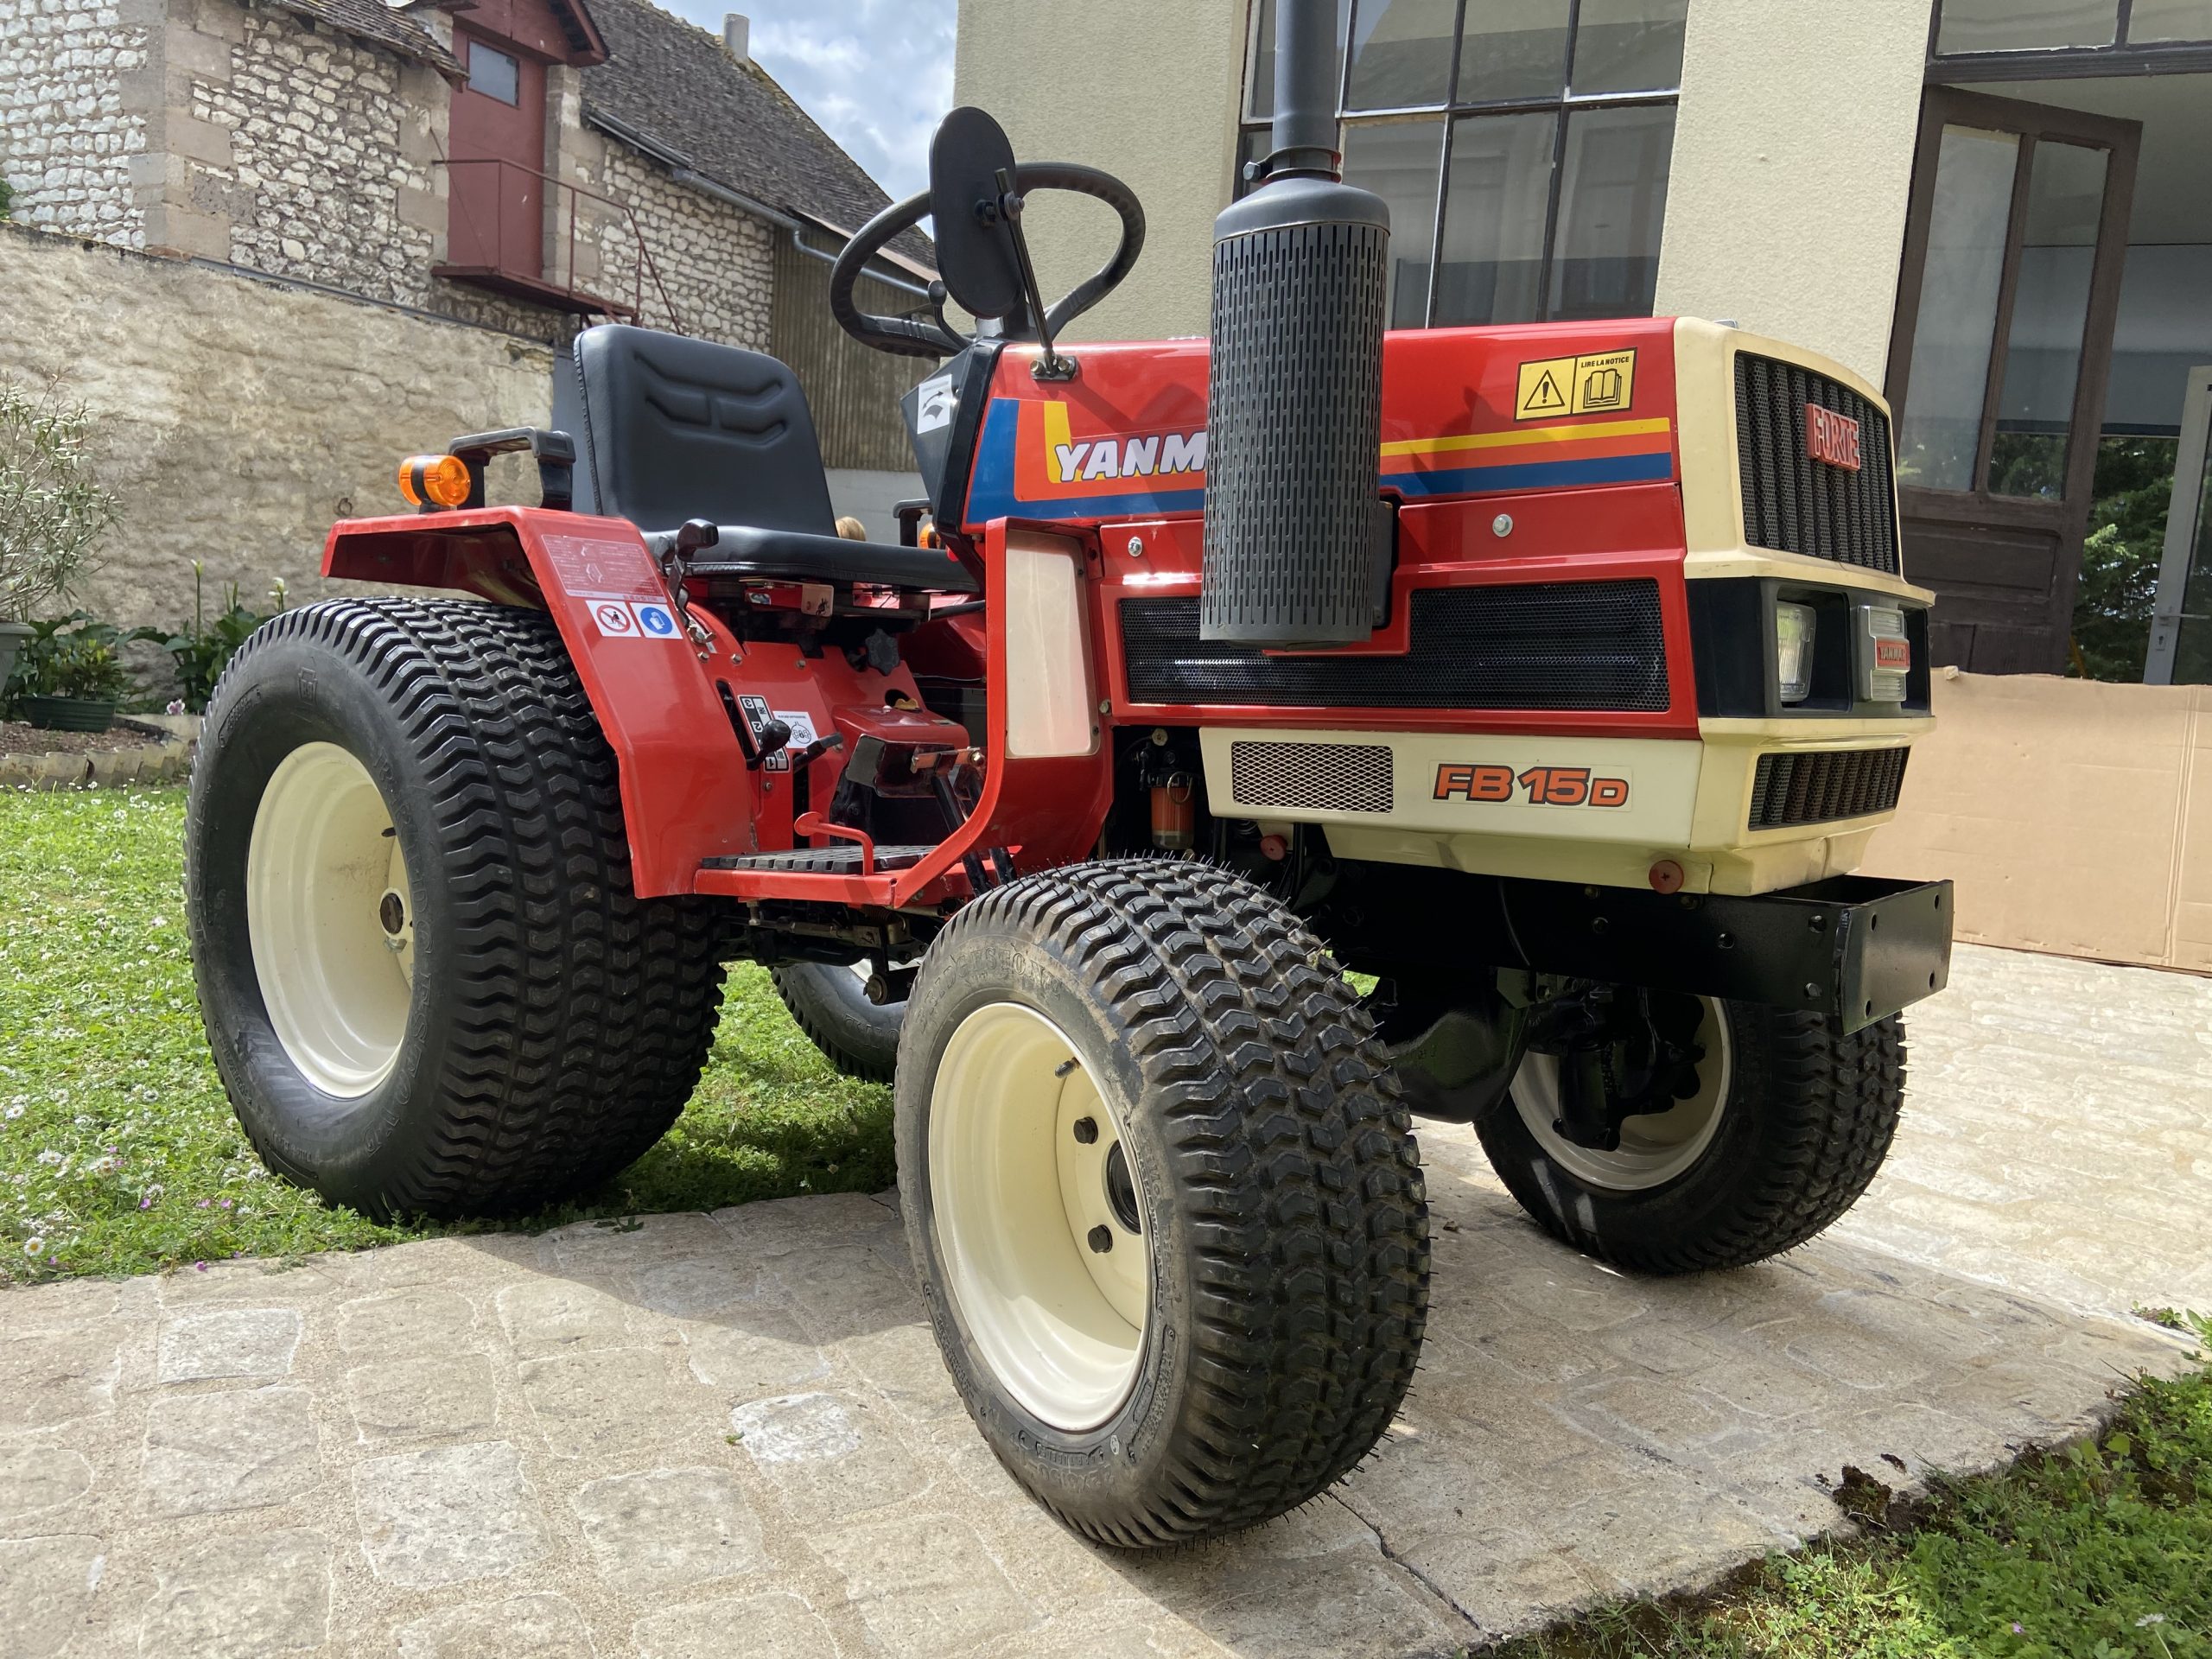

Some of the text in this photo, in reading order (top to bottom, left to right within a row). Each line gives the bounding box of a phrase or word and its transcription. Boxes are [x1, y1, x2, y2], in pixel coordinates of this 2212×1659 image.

[1605, 356, 1630, 365] NOTICE
[1812, 404, 1860, 470] FORTE
[1055, 430, 1208, 482] YANM
[753, 722, 761, 731] 2
